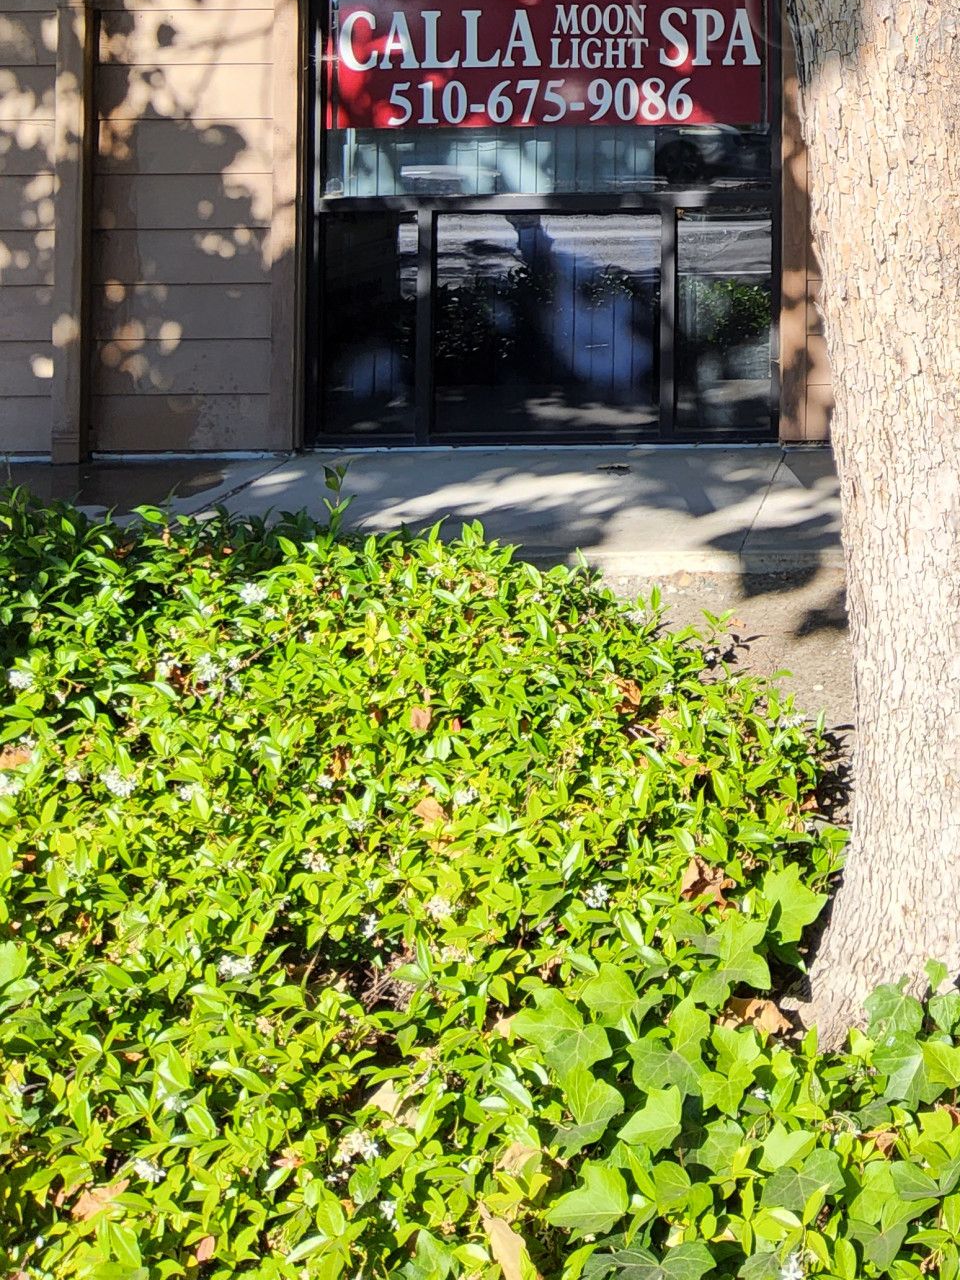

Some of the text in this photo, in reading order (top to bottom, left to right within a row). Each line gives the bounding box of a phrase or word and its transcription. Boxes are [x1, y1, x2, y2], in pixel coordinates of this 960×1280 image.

[339, 4, 762, 72] CALLA MOON LIGHT SPA
[388, 78, 694, 126] 510-675-9086
